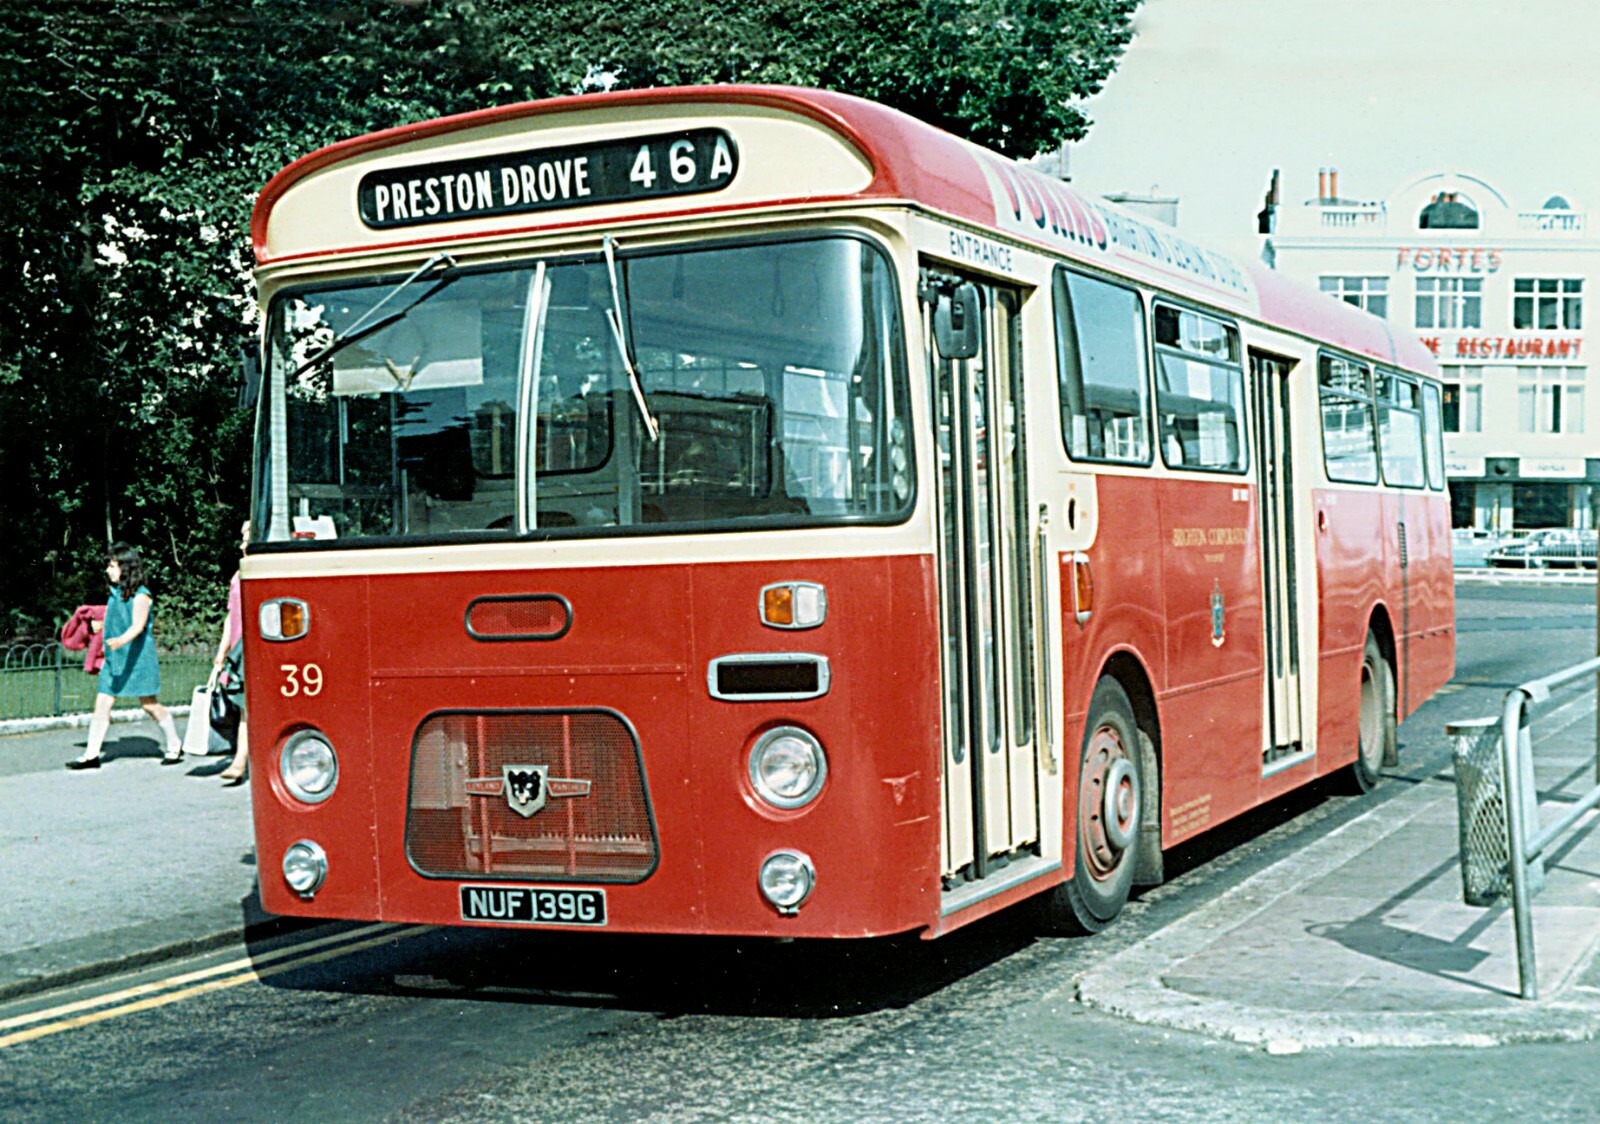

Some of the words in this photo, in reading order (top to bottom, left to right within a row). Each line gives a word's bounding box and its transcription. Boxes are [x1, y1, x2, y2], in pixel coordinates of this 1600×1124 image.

[375, 169, 494, 221] PRESTON
[501, 156, 591, 206] DROVE
[949, 230, 1013, 272] ENTRANCE
[1396, 246, 1503, 272] FORTES
[1457, 336, 1584, 359] RESTAURANT
[280, 662, 324, 698] 39
[469, 888, 525, 919] NUF
[531, 891, 597, 921] 139G
